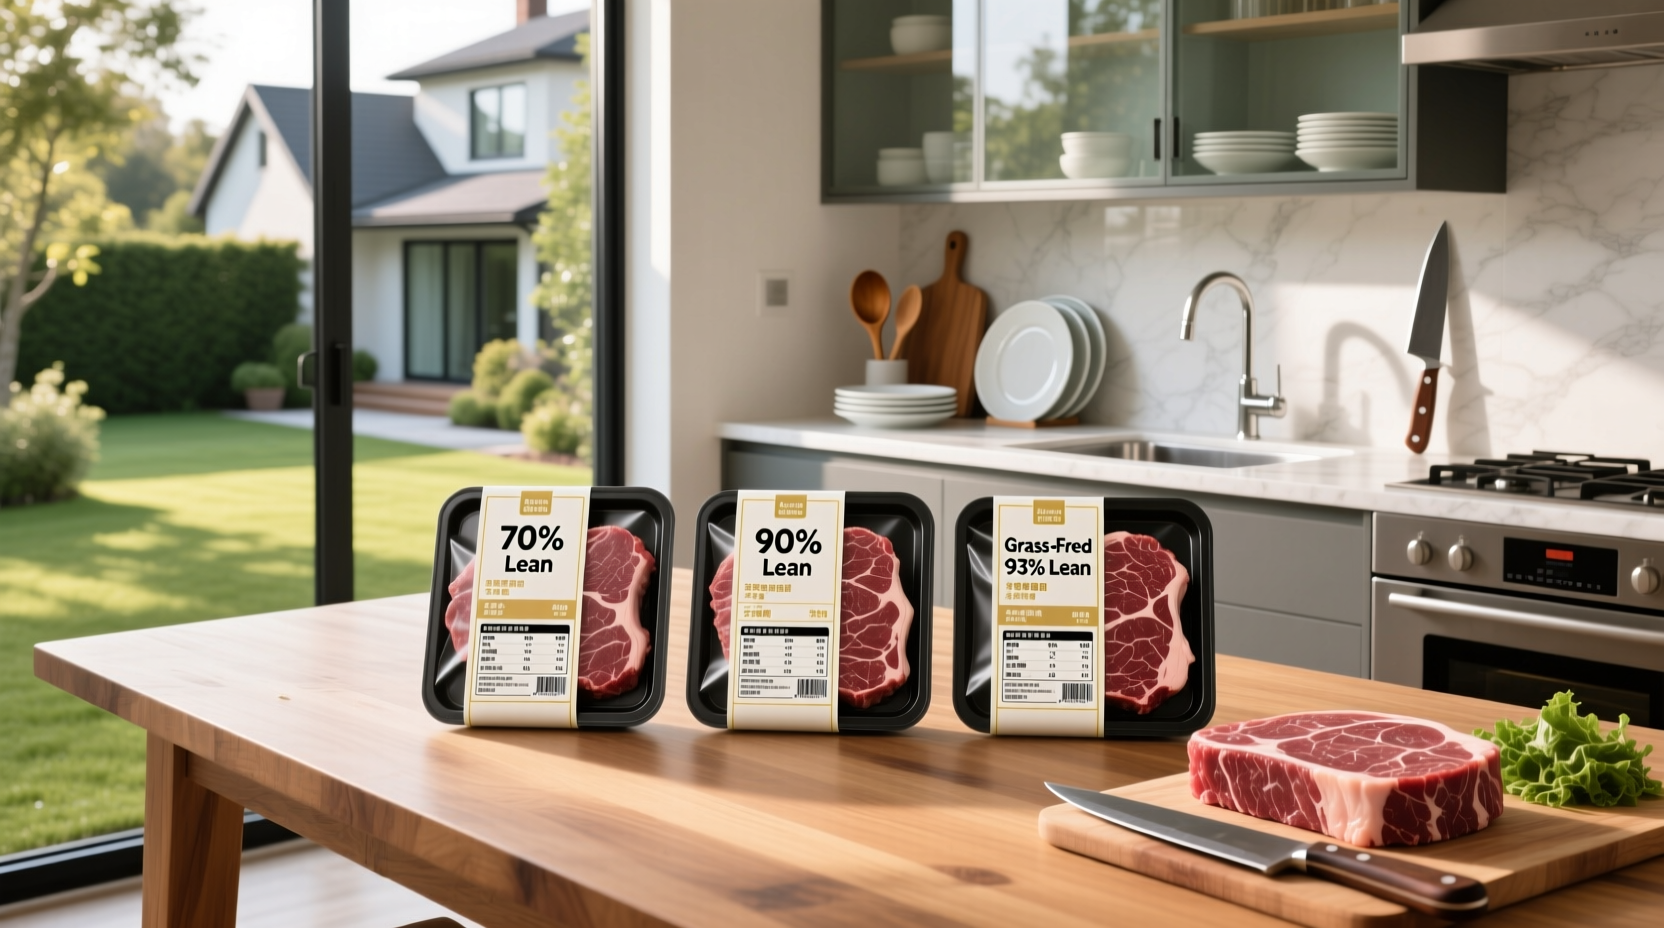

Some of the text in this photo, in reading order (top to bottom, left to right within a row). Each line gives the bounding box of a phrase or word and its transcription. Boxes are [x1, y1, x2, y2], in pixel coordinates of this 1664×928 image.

[501, 525, 564, 550] 70%
[755, 528, 822, 554] 90%
[1004, 537, 1092, 553] Grass-Fred
[505, 555, 553, 572] Lean
[763, 558, 812, 576] Lean
[1004, 558, 1091, 576] 93% Lean
